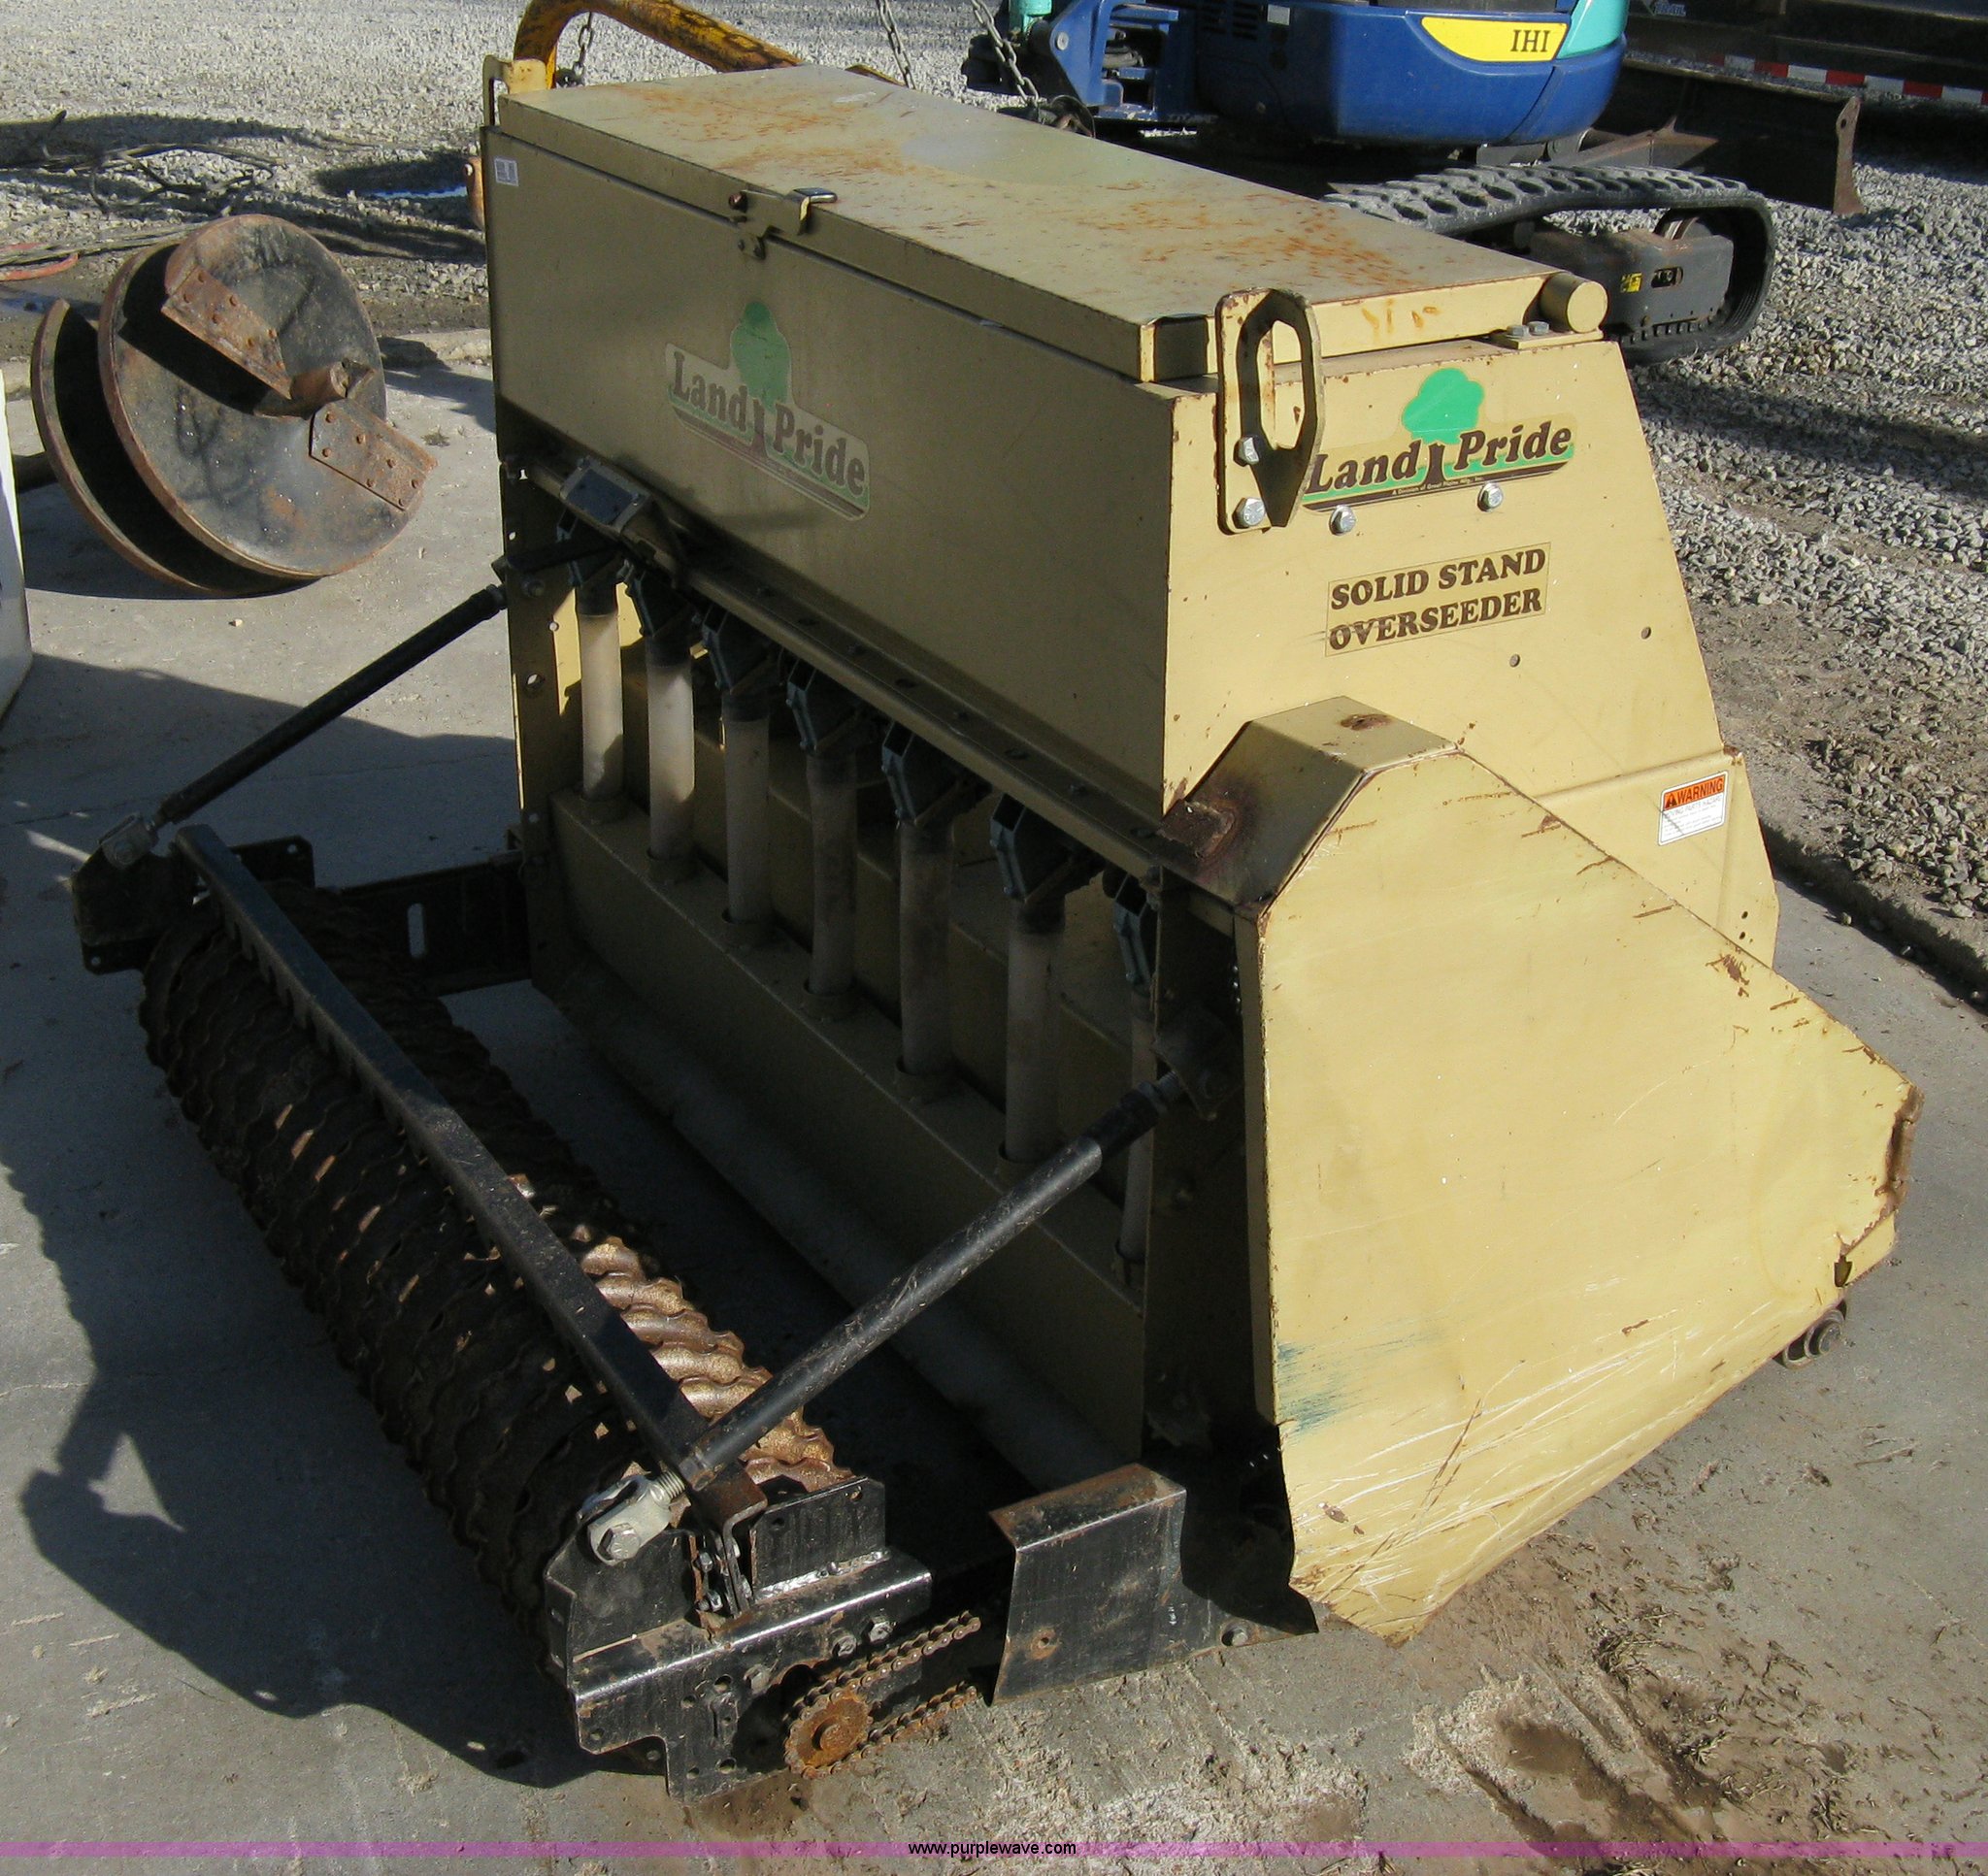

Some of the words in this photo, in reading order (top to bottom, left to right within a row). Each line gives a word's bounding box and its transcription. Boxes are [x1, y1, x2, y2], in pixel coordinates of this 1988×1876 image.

[1510, 29, 1550, 52] IHI
[674, 350, 748, 432] Land
[774, 402, 865, 496] Pride
[1304, 440, 1422, 494] Land
[1453, 421, 1572, 470] Pride
[1331, 570, 1430, 610] SOLID
[1438, 548, 1546, 589] STAND
[1329, 588, 1542, 650] OVERSEEDER
[1676, 777, 1723, 805] WARNING
